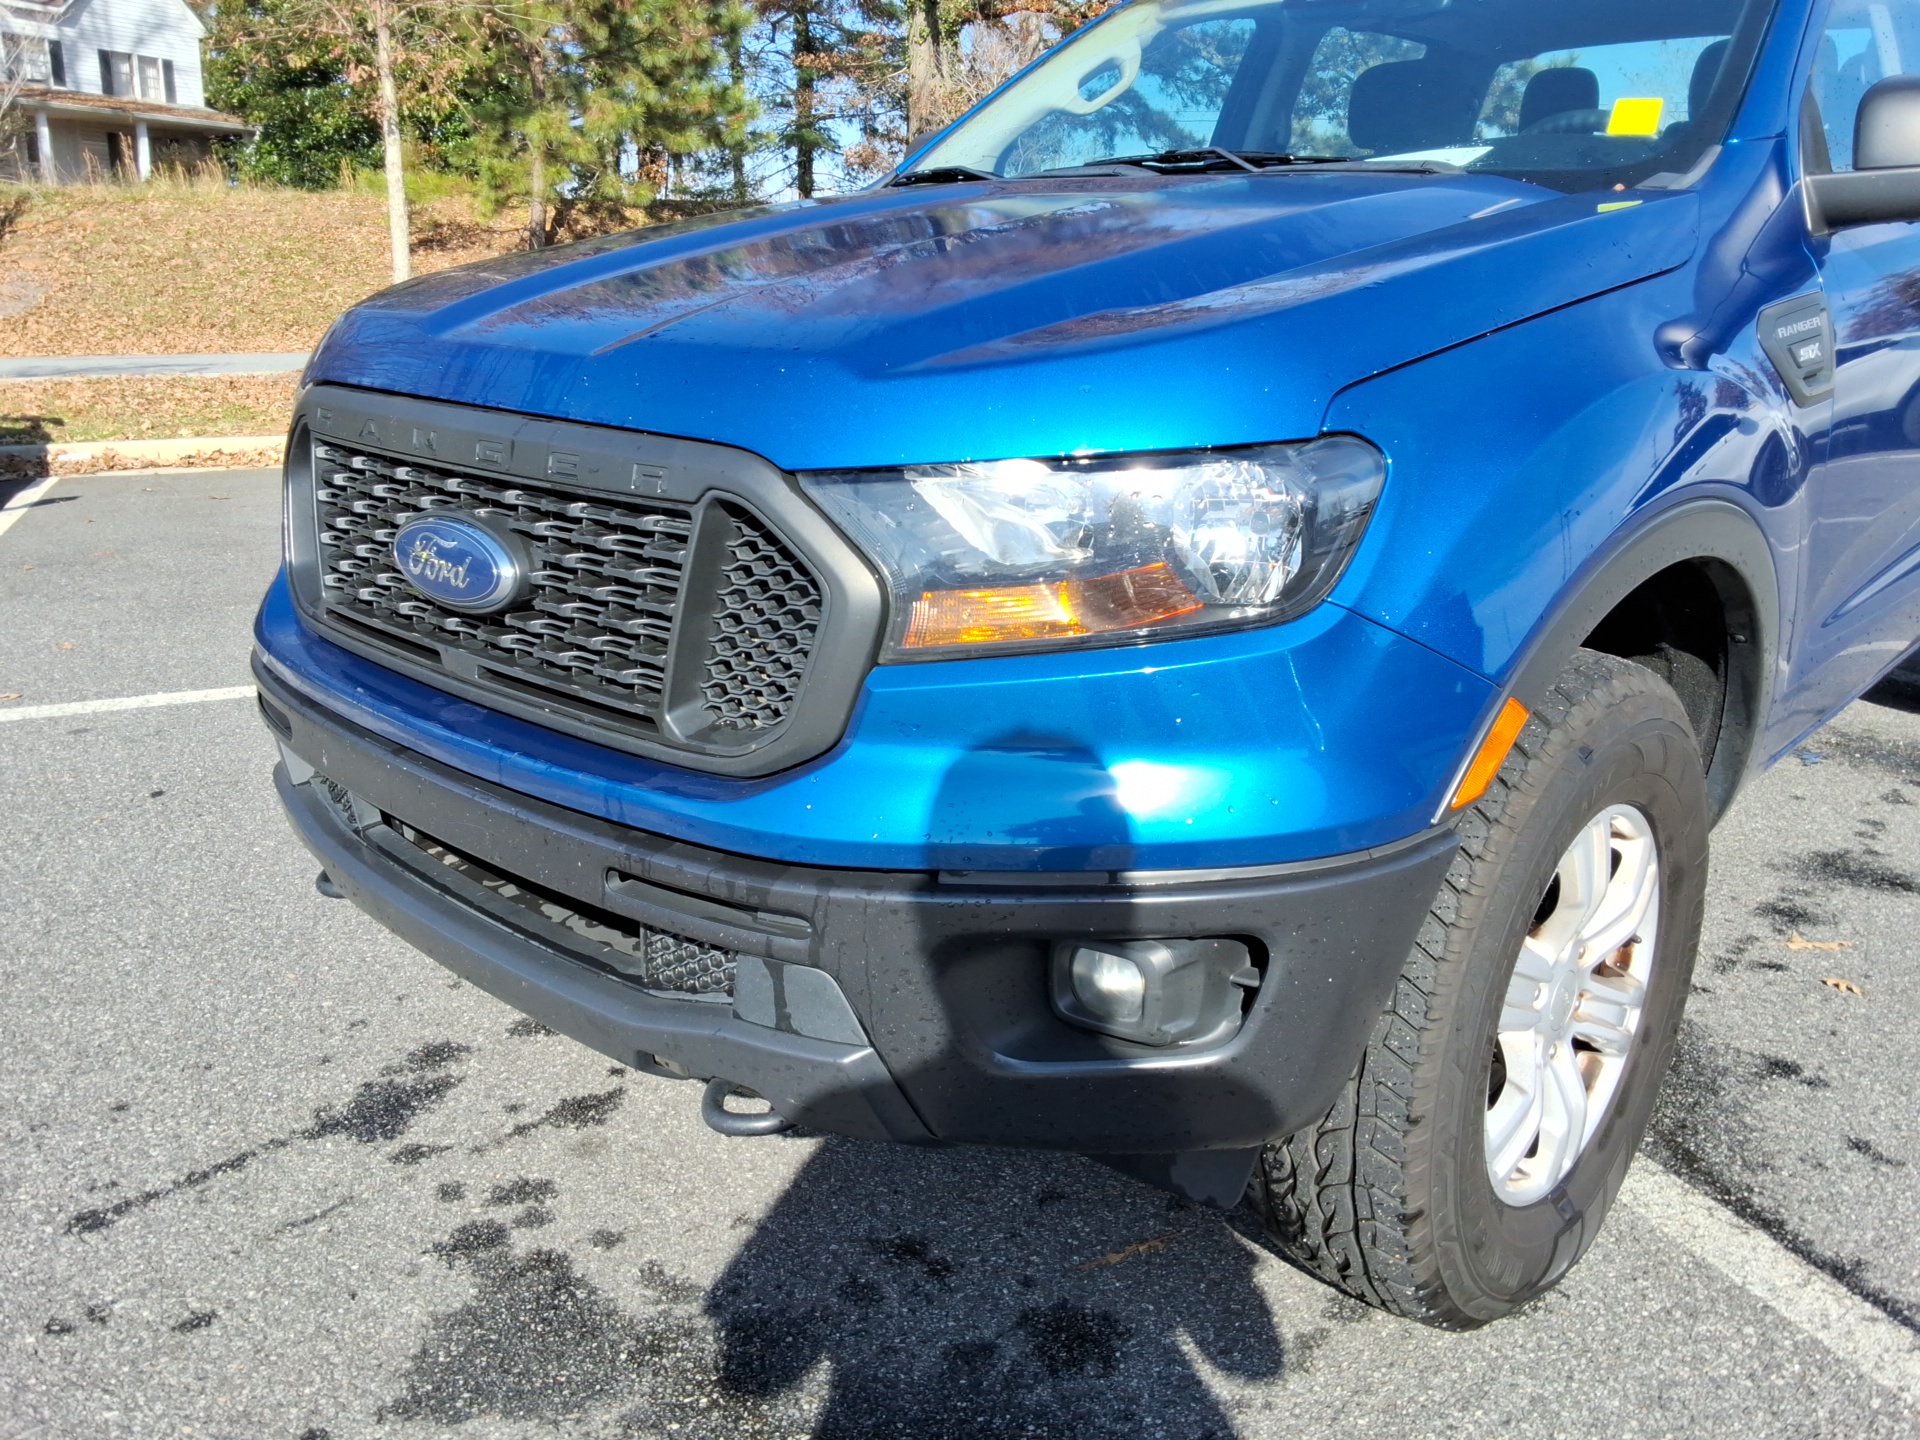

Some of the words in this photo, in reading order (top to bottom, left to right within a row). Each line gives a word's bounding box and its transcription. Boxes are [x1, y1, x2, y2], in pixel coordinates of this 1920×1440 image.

[1778, 316, 1821, 338] RANGER
[316, 407, 670, 494] RANGER
[405, 531, 473, 589] Ford
